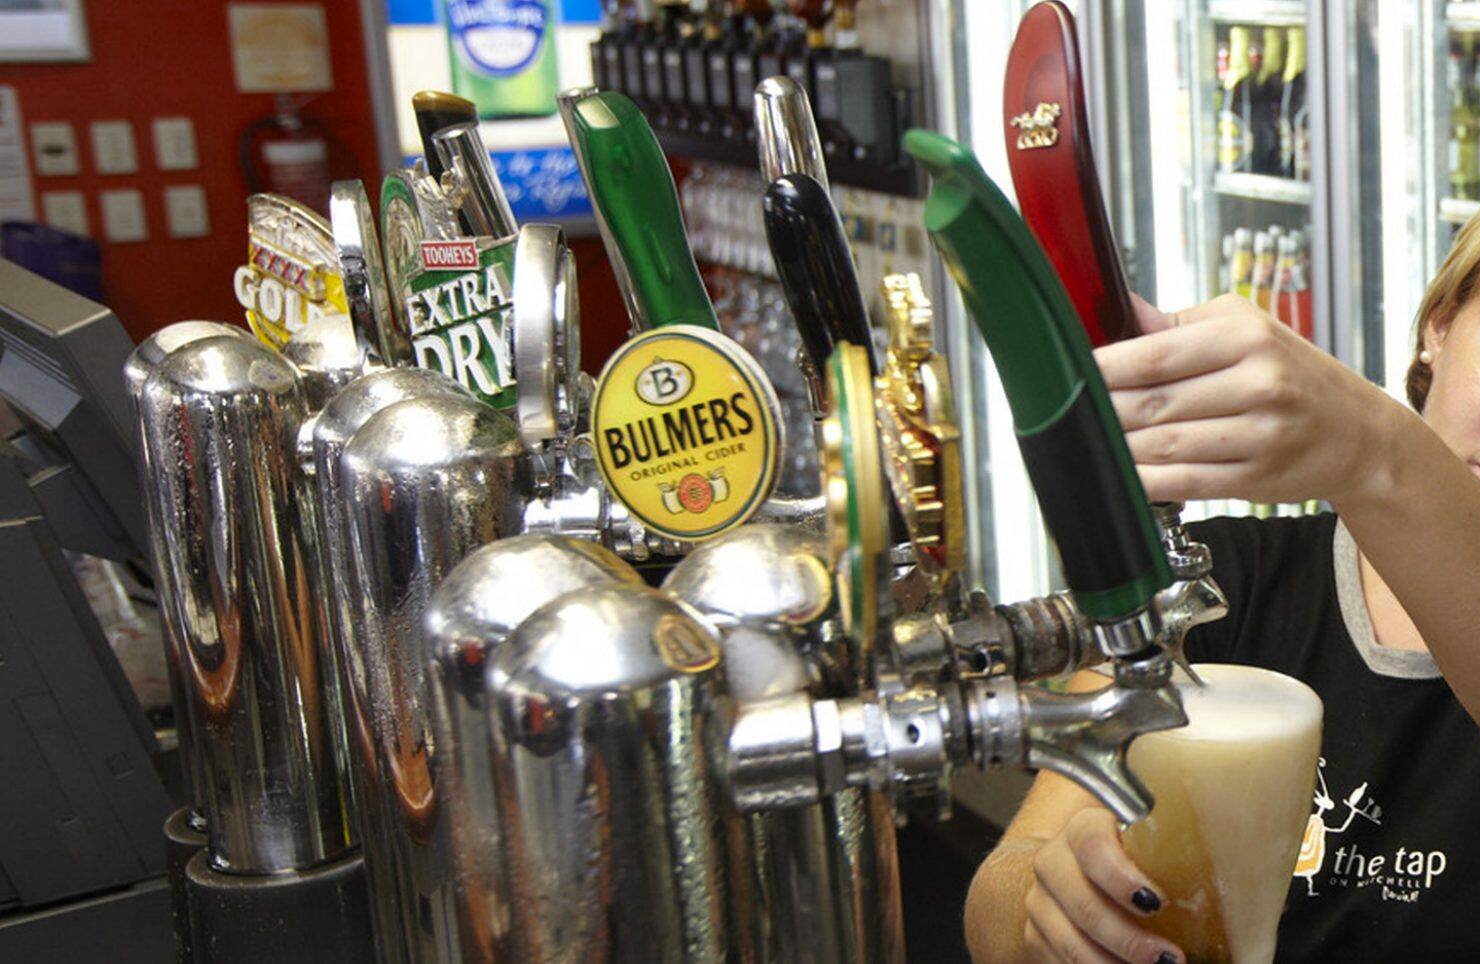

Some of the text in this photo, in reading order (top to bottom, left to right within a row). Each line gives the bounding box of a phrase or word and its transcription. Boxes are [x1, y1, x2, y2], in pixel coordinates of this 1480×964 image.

[422, 245, 475, 264] TOOHEYS
[406, 262, 513, 336] EXTRA
[413, 308, 518, 395] DRY
[650, 367, 678, 398] B
[604, 392, 753, 470] BULMERS
[630, 442, 747, 482] ORIGINAL CIDER
[1334, 844, 1447, 889] the tap
